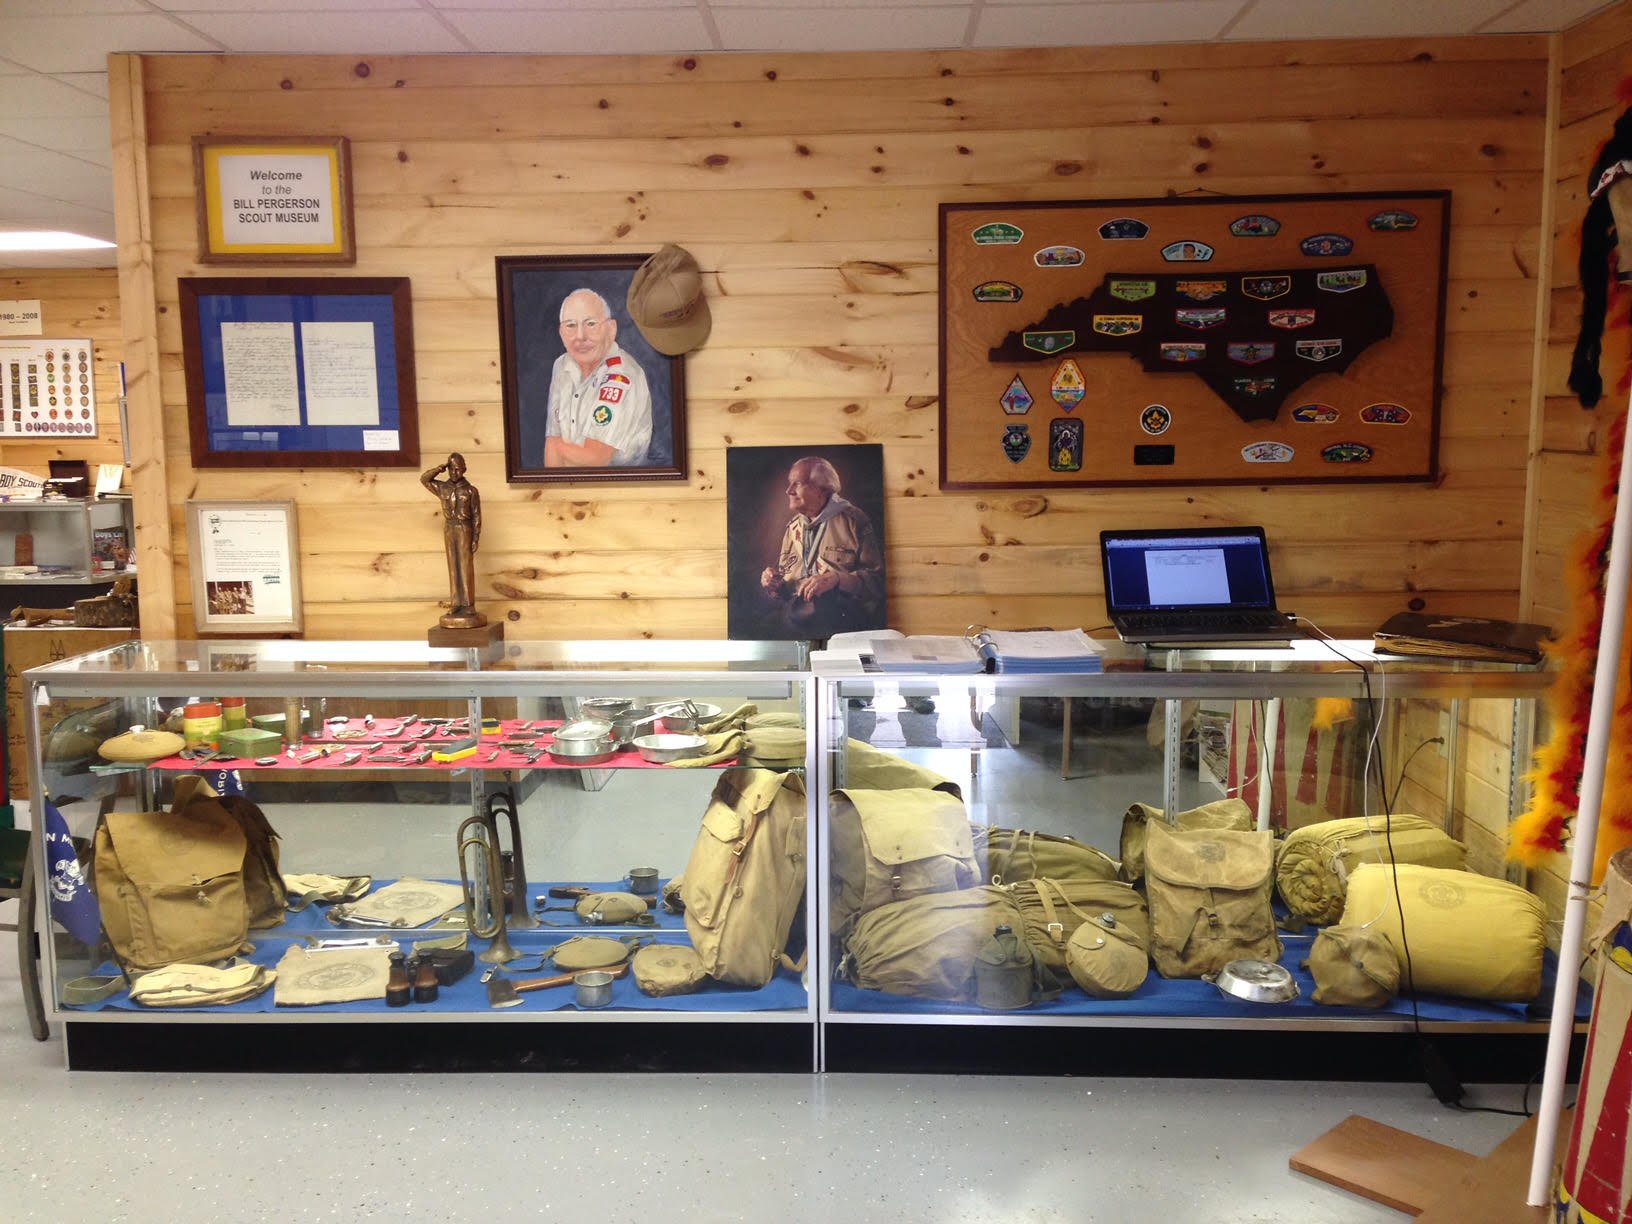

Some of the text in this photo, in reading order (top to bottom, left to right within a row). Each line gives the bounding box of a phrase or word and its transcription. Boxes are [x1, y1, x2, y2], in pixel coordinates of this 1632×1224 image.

[250, 170, 303, 180] Welcome
[262, 185, 292, 195] to the
[233, 198, 320, 209] BILL PERGERSON
[238, 212, 319, 223] SCOUT MUSEUM
[602, 387, 620, 401] 733
[0, 473, 17, 488] BOY
